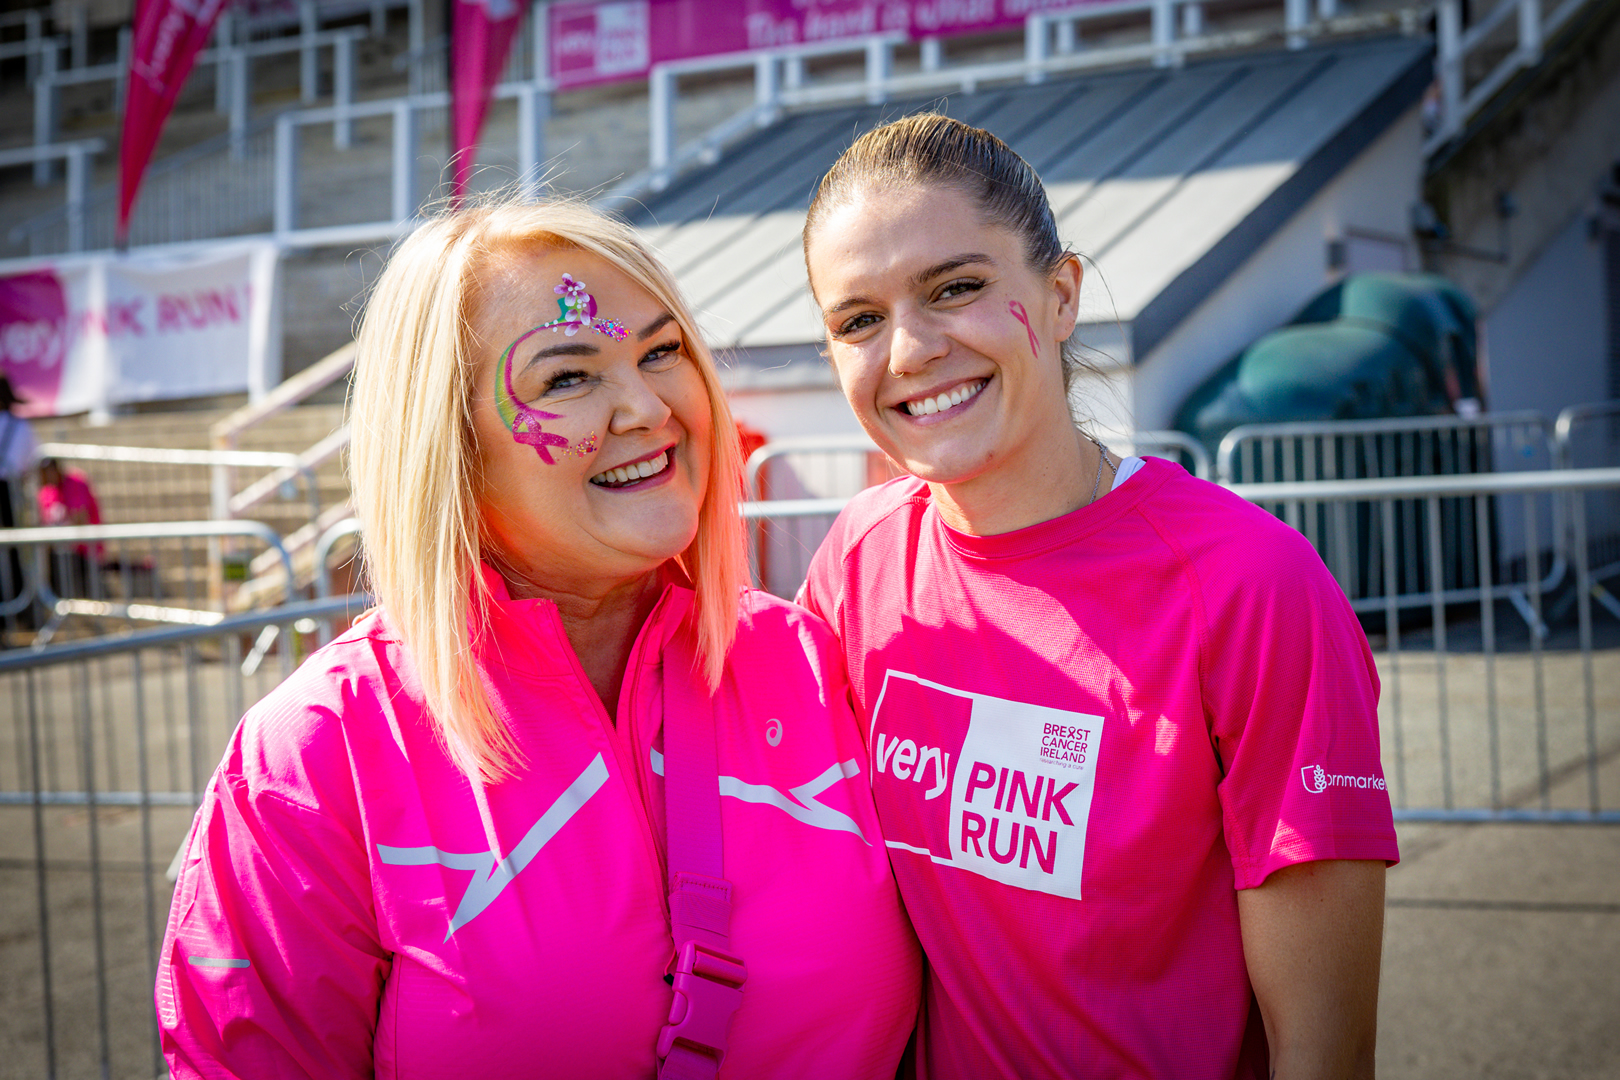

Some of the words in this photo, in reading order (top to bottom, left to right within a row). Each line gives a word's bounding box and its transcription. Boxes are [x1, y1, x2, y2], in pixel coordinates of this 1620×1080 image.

[157, 284, 240, 334] RUN
[0, 315, 65, 370] ery
[876, 733, 950, 801] very
[1040, 746, 1086, 764] IRELAND
[1041, 736, 1088, 753] CANCER
[964, 761, 1080, 827] PINK
[961, 810, 1058, 875] RUN
